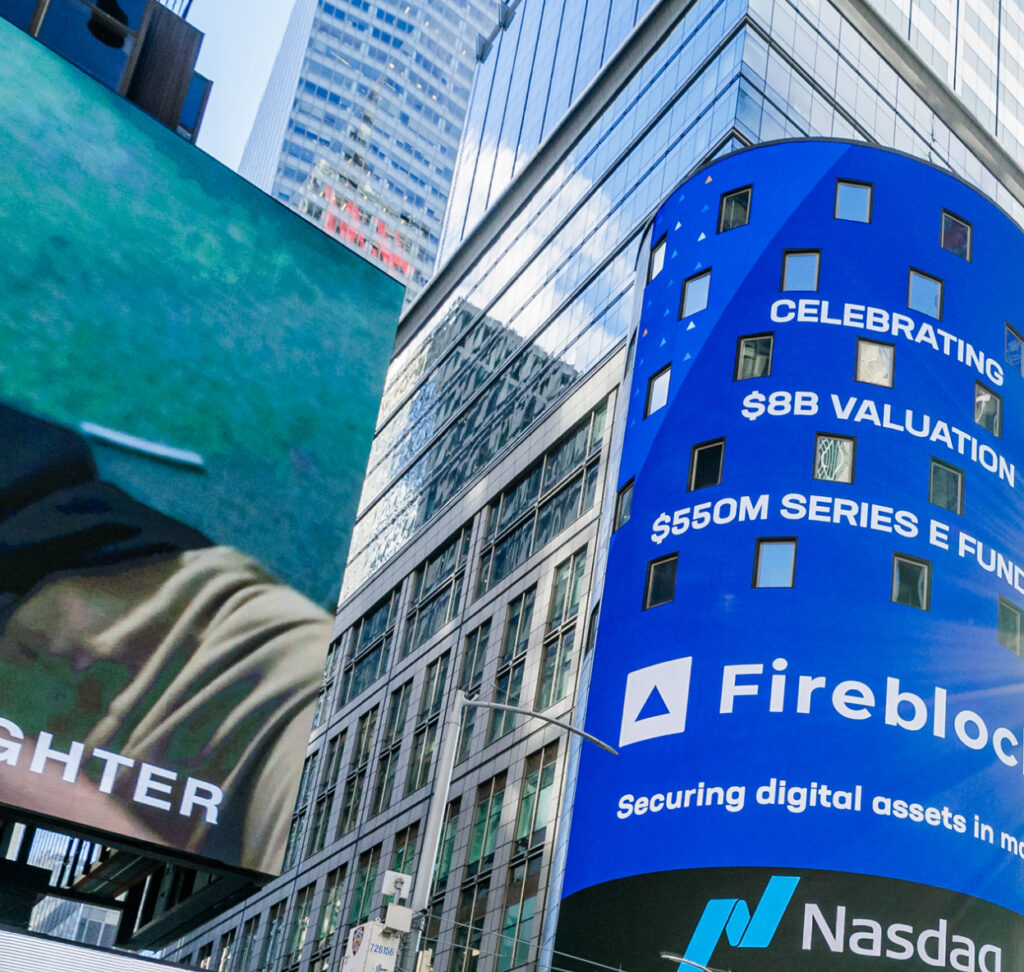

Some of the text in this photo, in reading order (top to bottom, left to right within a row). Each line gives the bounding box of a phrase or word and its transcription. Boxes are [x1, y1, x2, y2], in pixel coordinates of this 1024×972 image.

[770, 299, 1004, 387] CELEBRATING
[742, 390, 1015, 488] $8B VALUATION
[652, 494, 770, 546] $550M
[780, 493, 919, 539] SERIES
[929, 519, 950, 550] E
[616, 781, 747, 820] Securing
[756, 778, 862, 814] digital
[872, 796, 967, 834] assets
[973, 814, 994, 844] in
[370, 943, 396, 957] 726156
